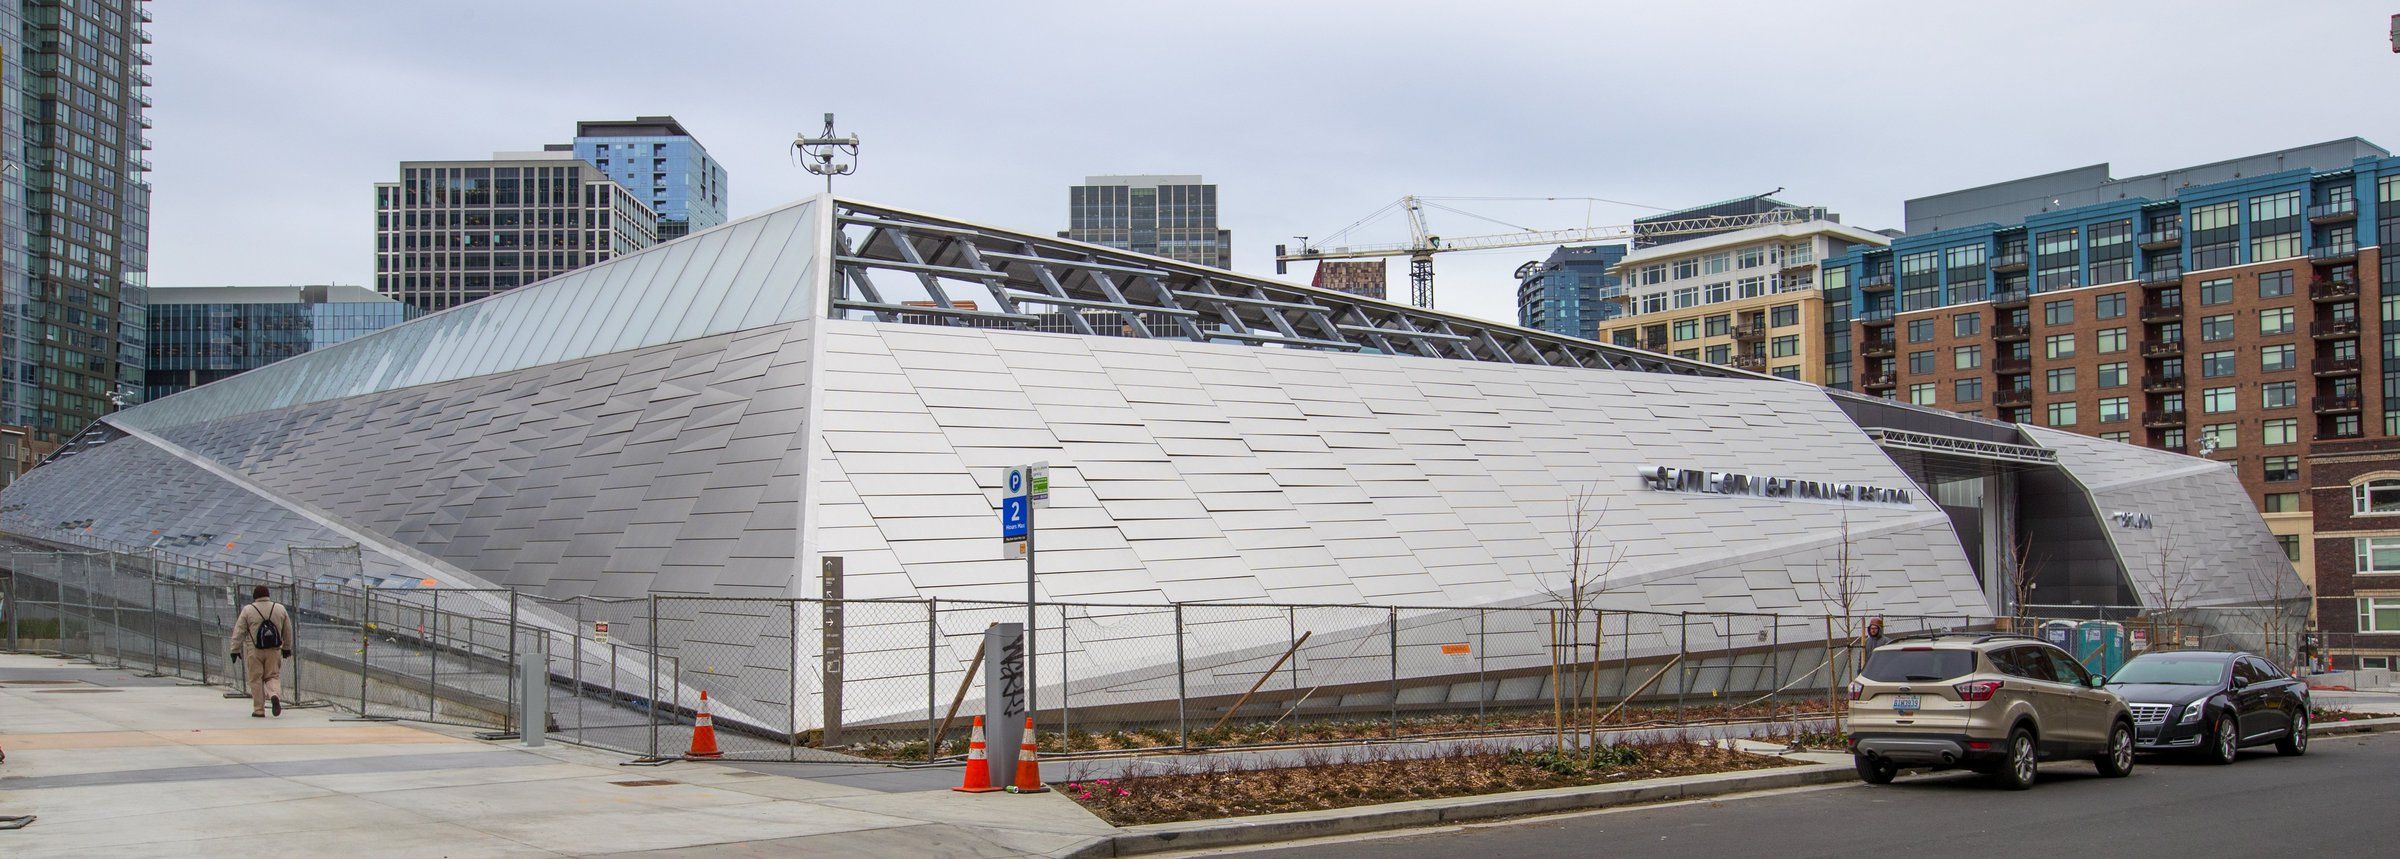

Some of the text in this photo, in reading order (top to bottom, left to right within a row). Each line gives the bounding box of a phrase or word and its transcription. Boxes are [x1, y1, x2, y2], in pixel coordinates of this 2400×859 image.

[1012, 475, 1019, 489] P
[1656, 465, 1719, 494] SEATTLE
[1757, 475, 1797, 499] LIGHT
[1011, 502, 1020, 522] 2
